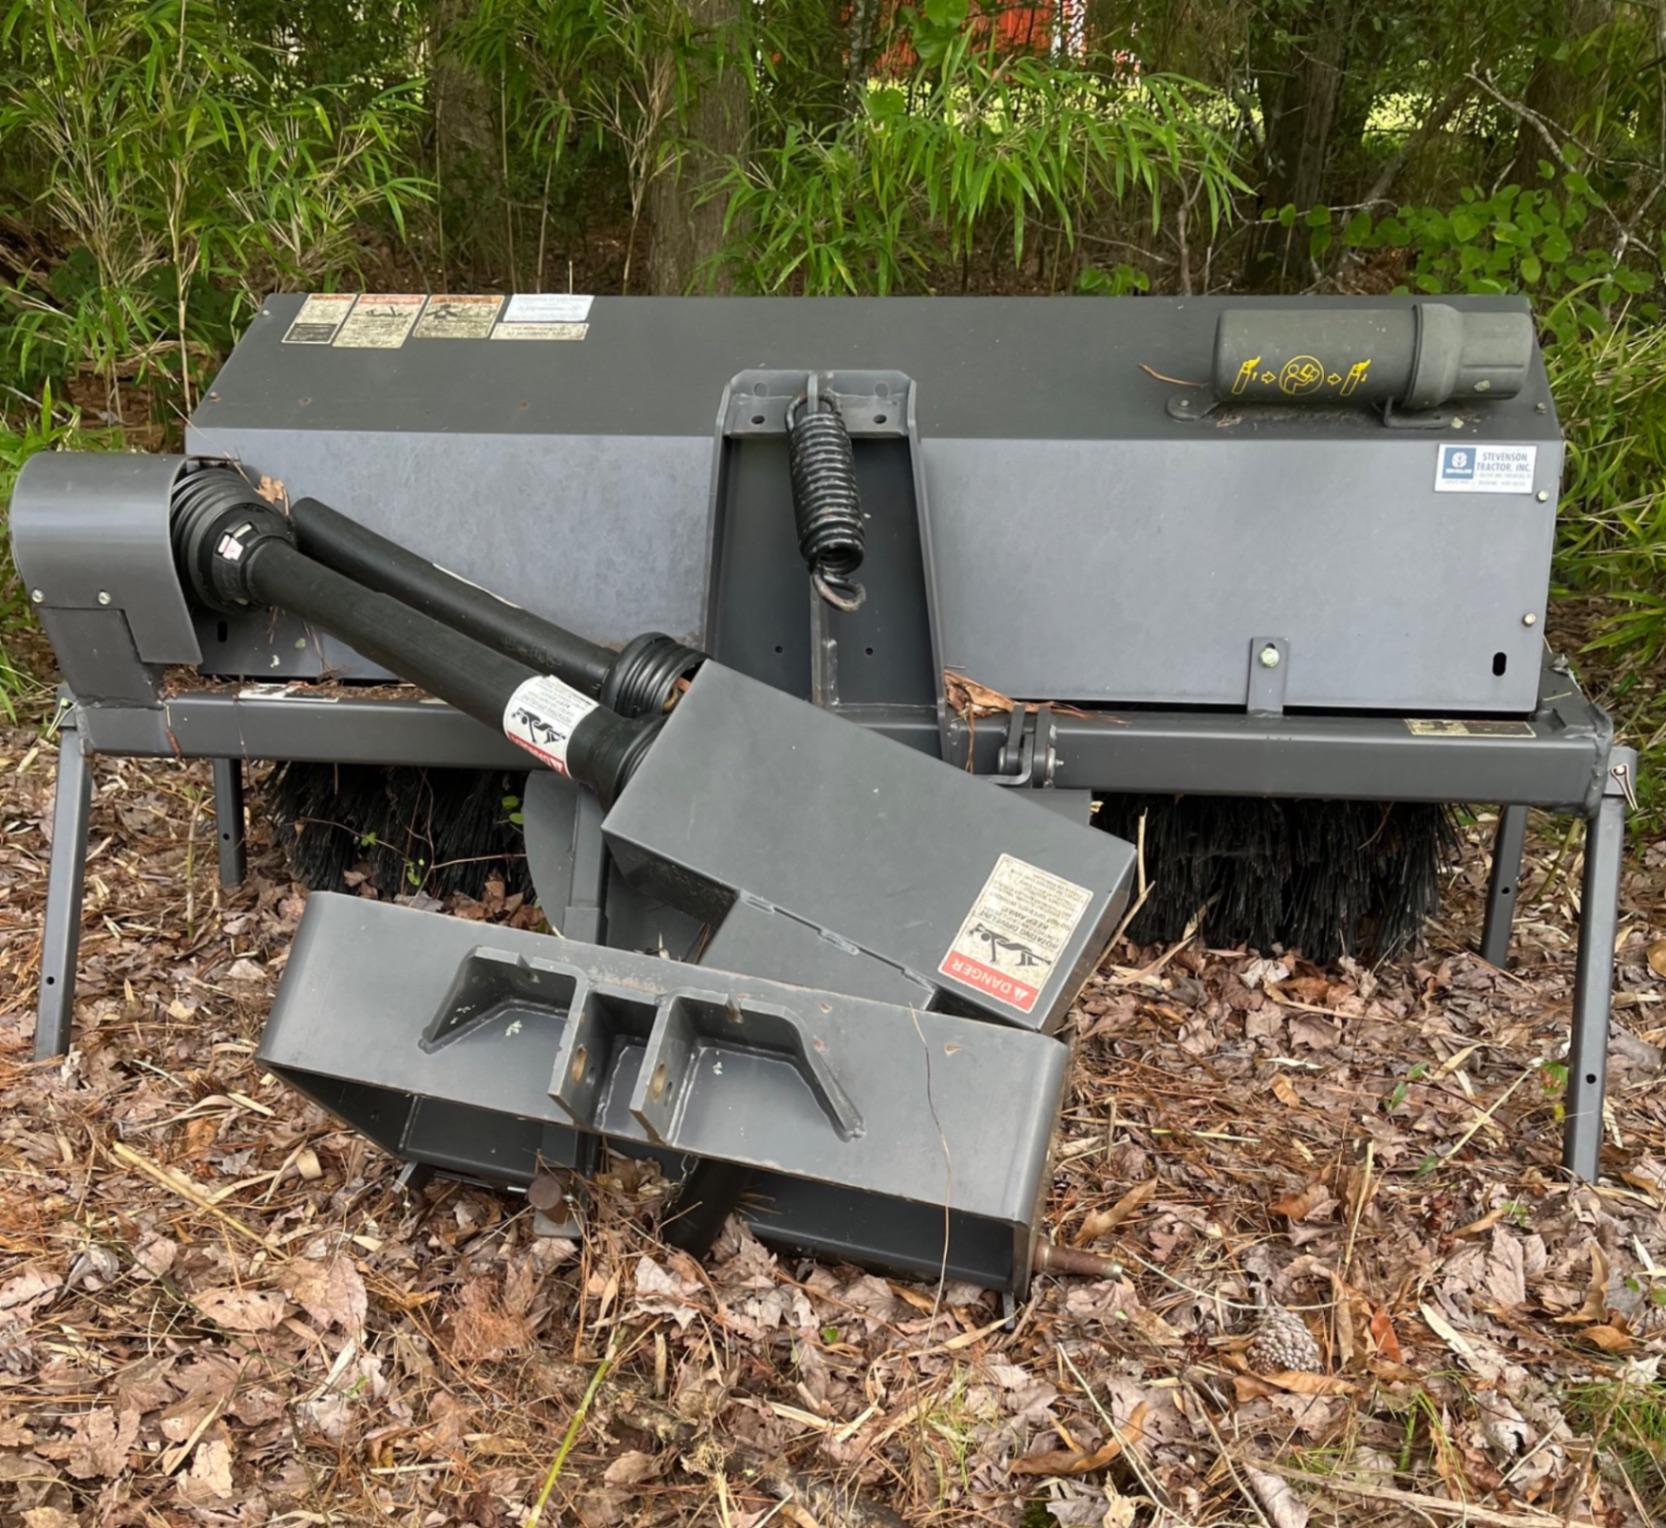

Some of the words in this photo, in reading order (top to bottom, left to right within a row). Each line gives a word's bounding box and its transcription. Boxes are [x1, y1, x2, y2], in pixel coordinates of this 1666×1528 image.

[1482, 453, 1527, 461] STEVENSON
[1516, 464, 1531, 472] INC.
[949, 957, 1013, 994] DANGER
